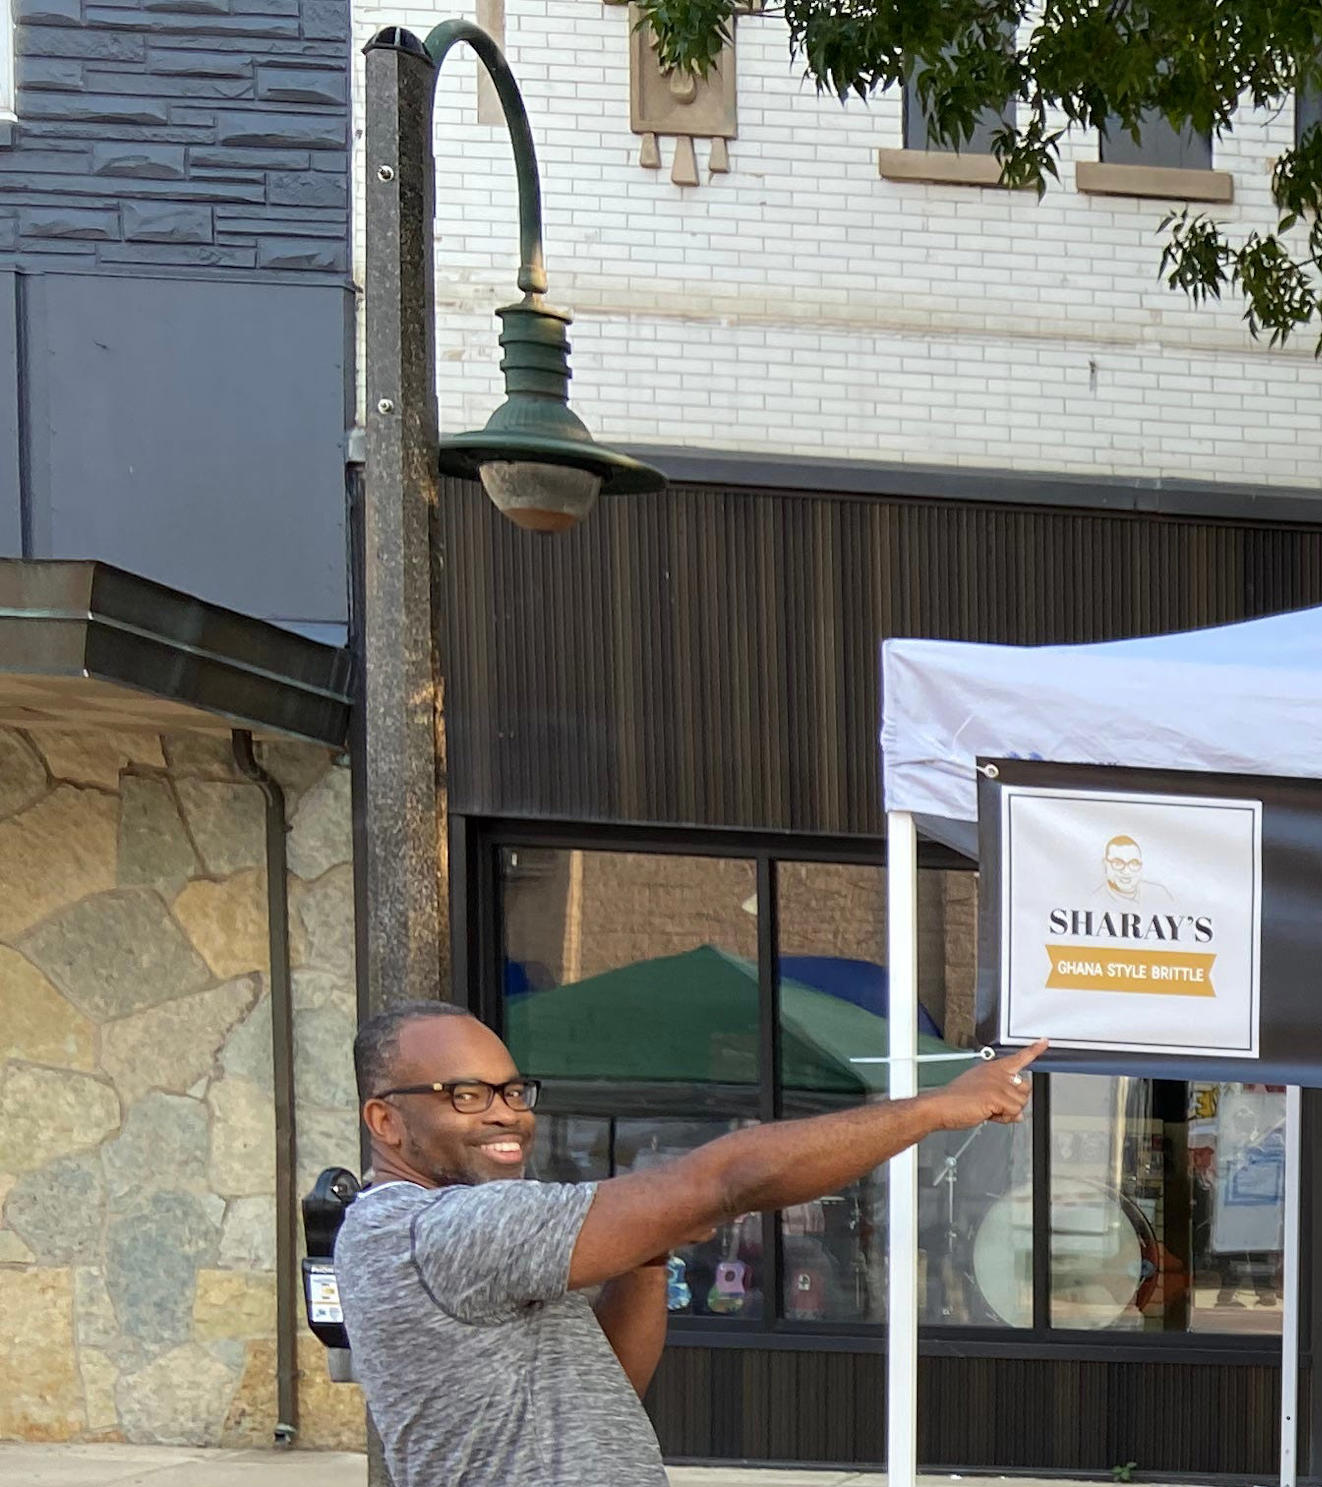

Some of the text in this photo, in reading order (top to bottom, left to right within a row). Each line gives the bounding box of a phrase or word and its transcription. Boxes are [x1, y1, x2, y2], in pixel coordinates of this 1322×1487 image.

[1049, 908, 1214, 944] SHARAY'S
[1057, 960, 1205, 983] GHANA STYLE BRITTLE
